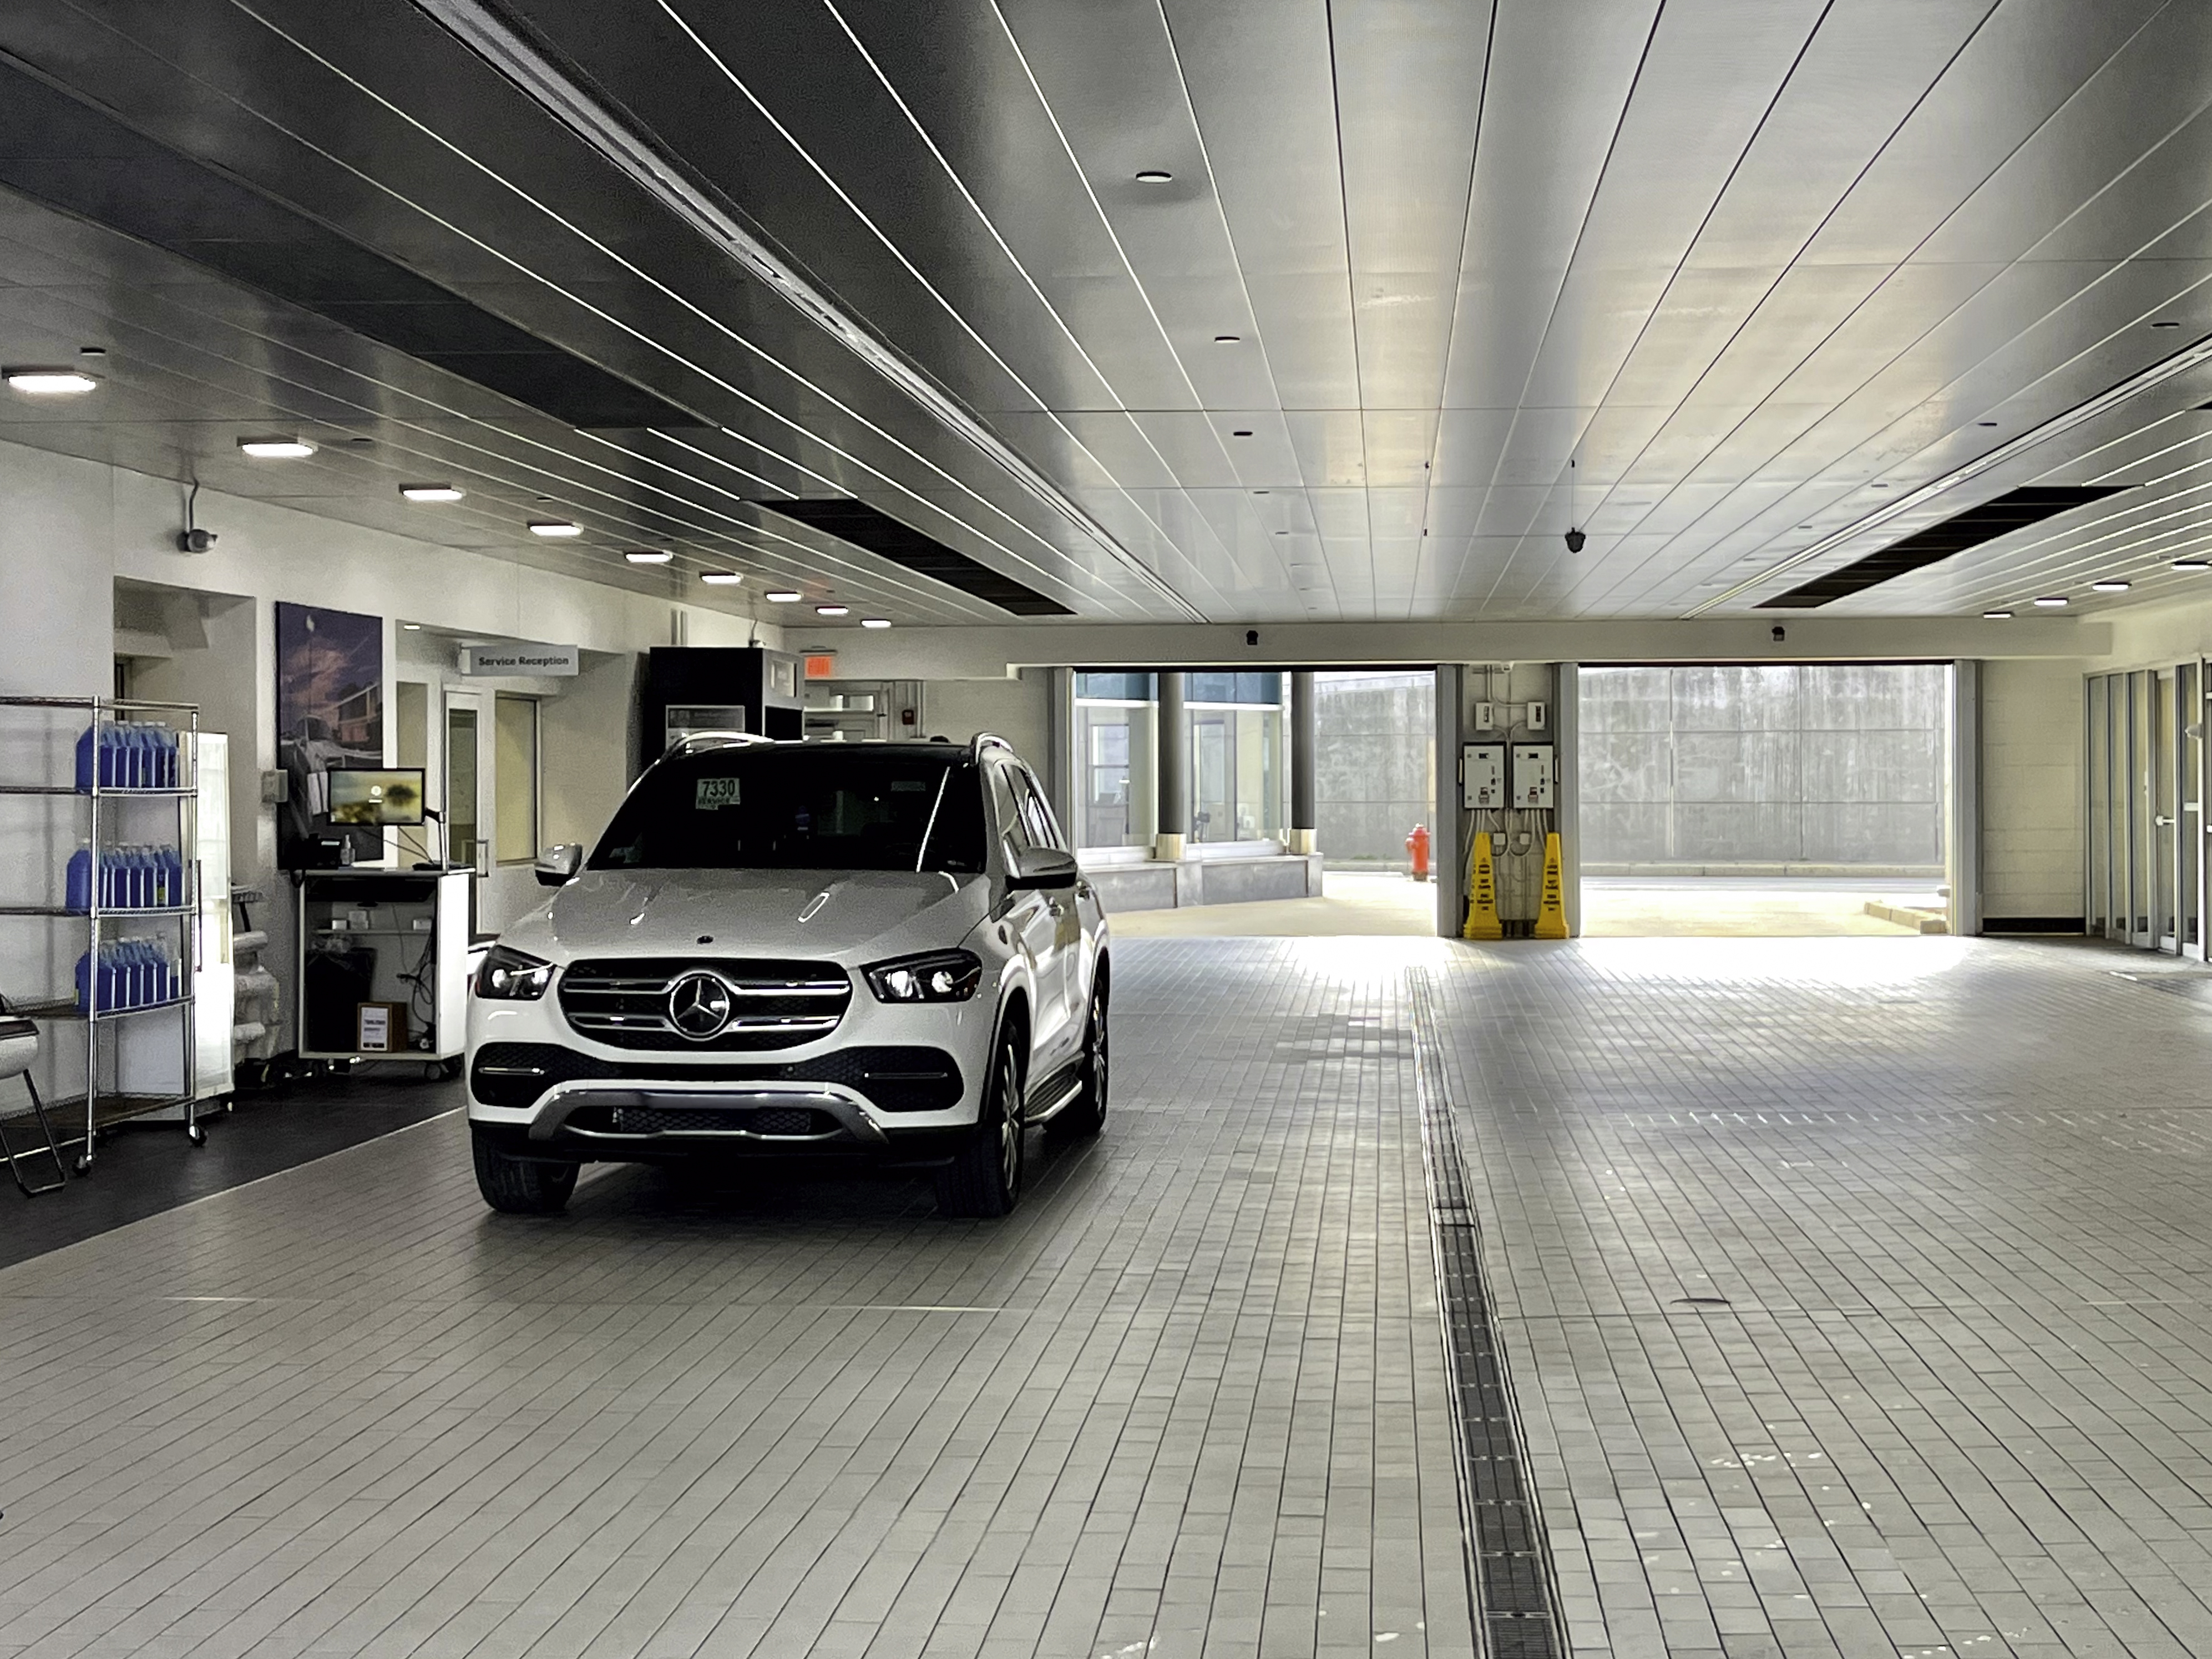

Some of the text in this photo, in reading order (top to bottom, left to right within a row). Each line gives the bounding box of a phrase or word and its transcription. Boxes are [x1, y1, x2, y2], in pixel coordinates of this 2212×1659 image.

[479, 656, 569, 667] Service Reception
[702, 780, 736, 797] 7330
